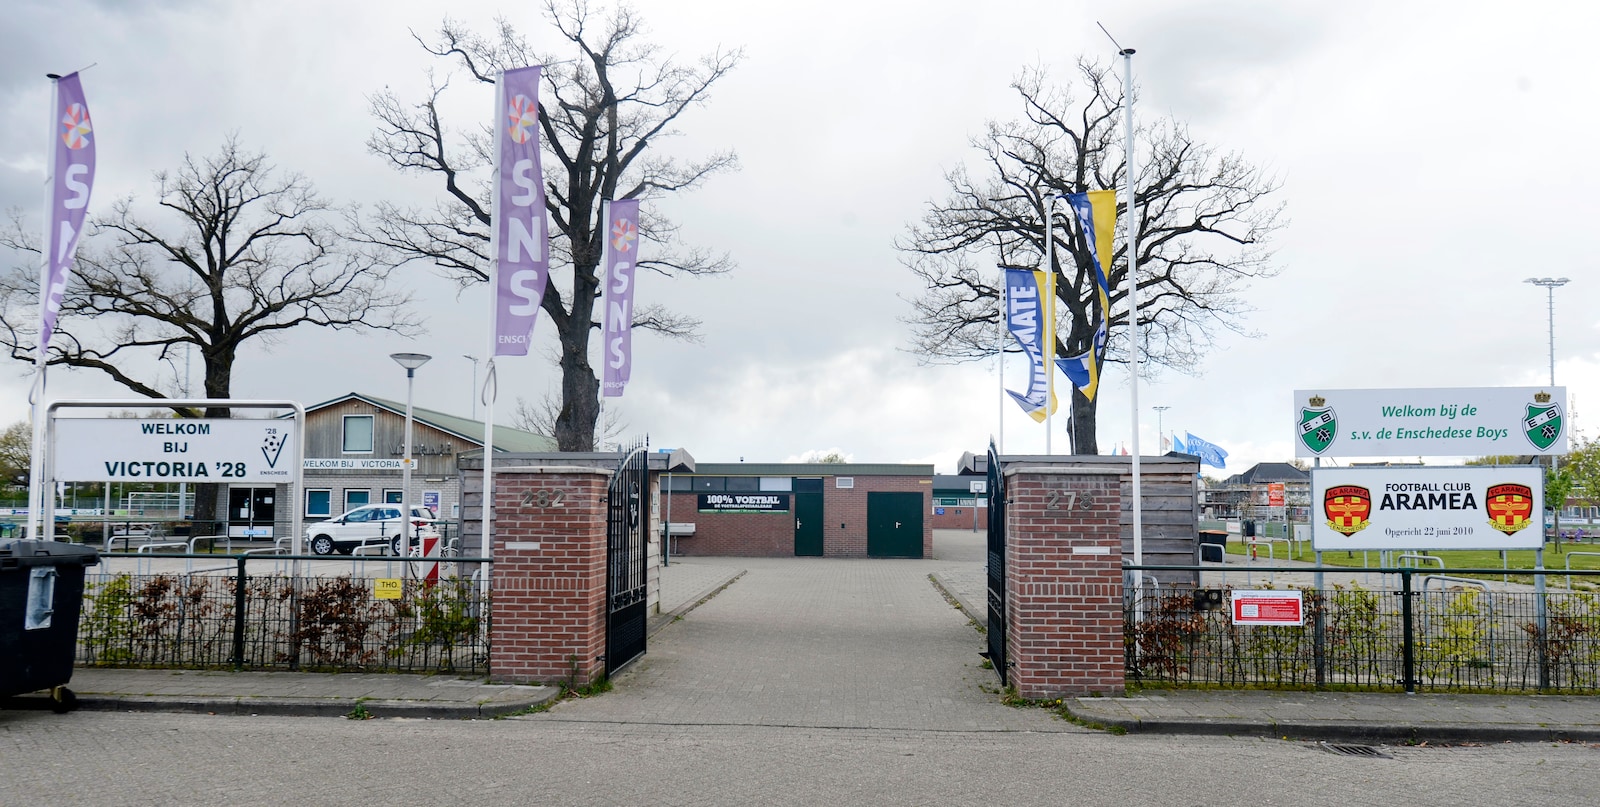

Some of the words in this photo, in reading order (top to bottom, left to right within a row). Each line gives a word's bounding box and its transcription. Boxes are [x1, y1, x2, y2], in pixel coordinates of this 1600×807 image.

[507, 159, 542, 317] SNS
[609, 261, 630, 370] SNS
[1381, 404, 1436, 418] Welkom
[1440, 403, 1458, 420] bij
[1461, 403, 1477, 417] de
[141, 423, 211, 435] WELKOM
[1351, 430, 1373, 440] s.v.
[1376, 427, 1393, 440] de
[1396, 426, 1473, 440] Enschedese
[1476, 425, 1509, 442] Boys
[163, 442, 188, 453] BIJ
[105, 461, 209, 477] VICTORIA
[341, 460, 354, 468] BIJ
[361, 460, 401, 468] VICTORIA
[1385, 483, 1441, 492] FOOTBALL
[1443, 482, 1471, 492] CLUB
[520, 488, 566, 508] 282
[707, 495, 733, 504] 100%
[735, 496, 780, 504] VOETBAL
[1046, 490, 1095, 511] 278
[1380, 493, 1478, 511] ARAMEA
[1384, 526, 1422, 538] Opgericht
[1424, 526, 1434, 536] 22
[1435, 526, 1451, 538] juni
[1453, 526, 1474, 536] 2010
